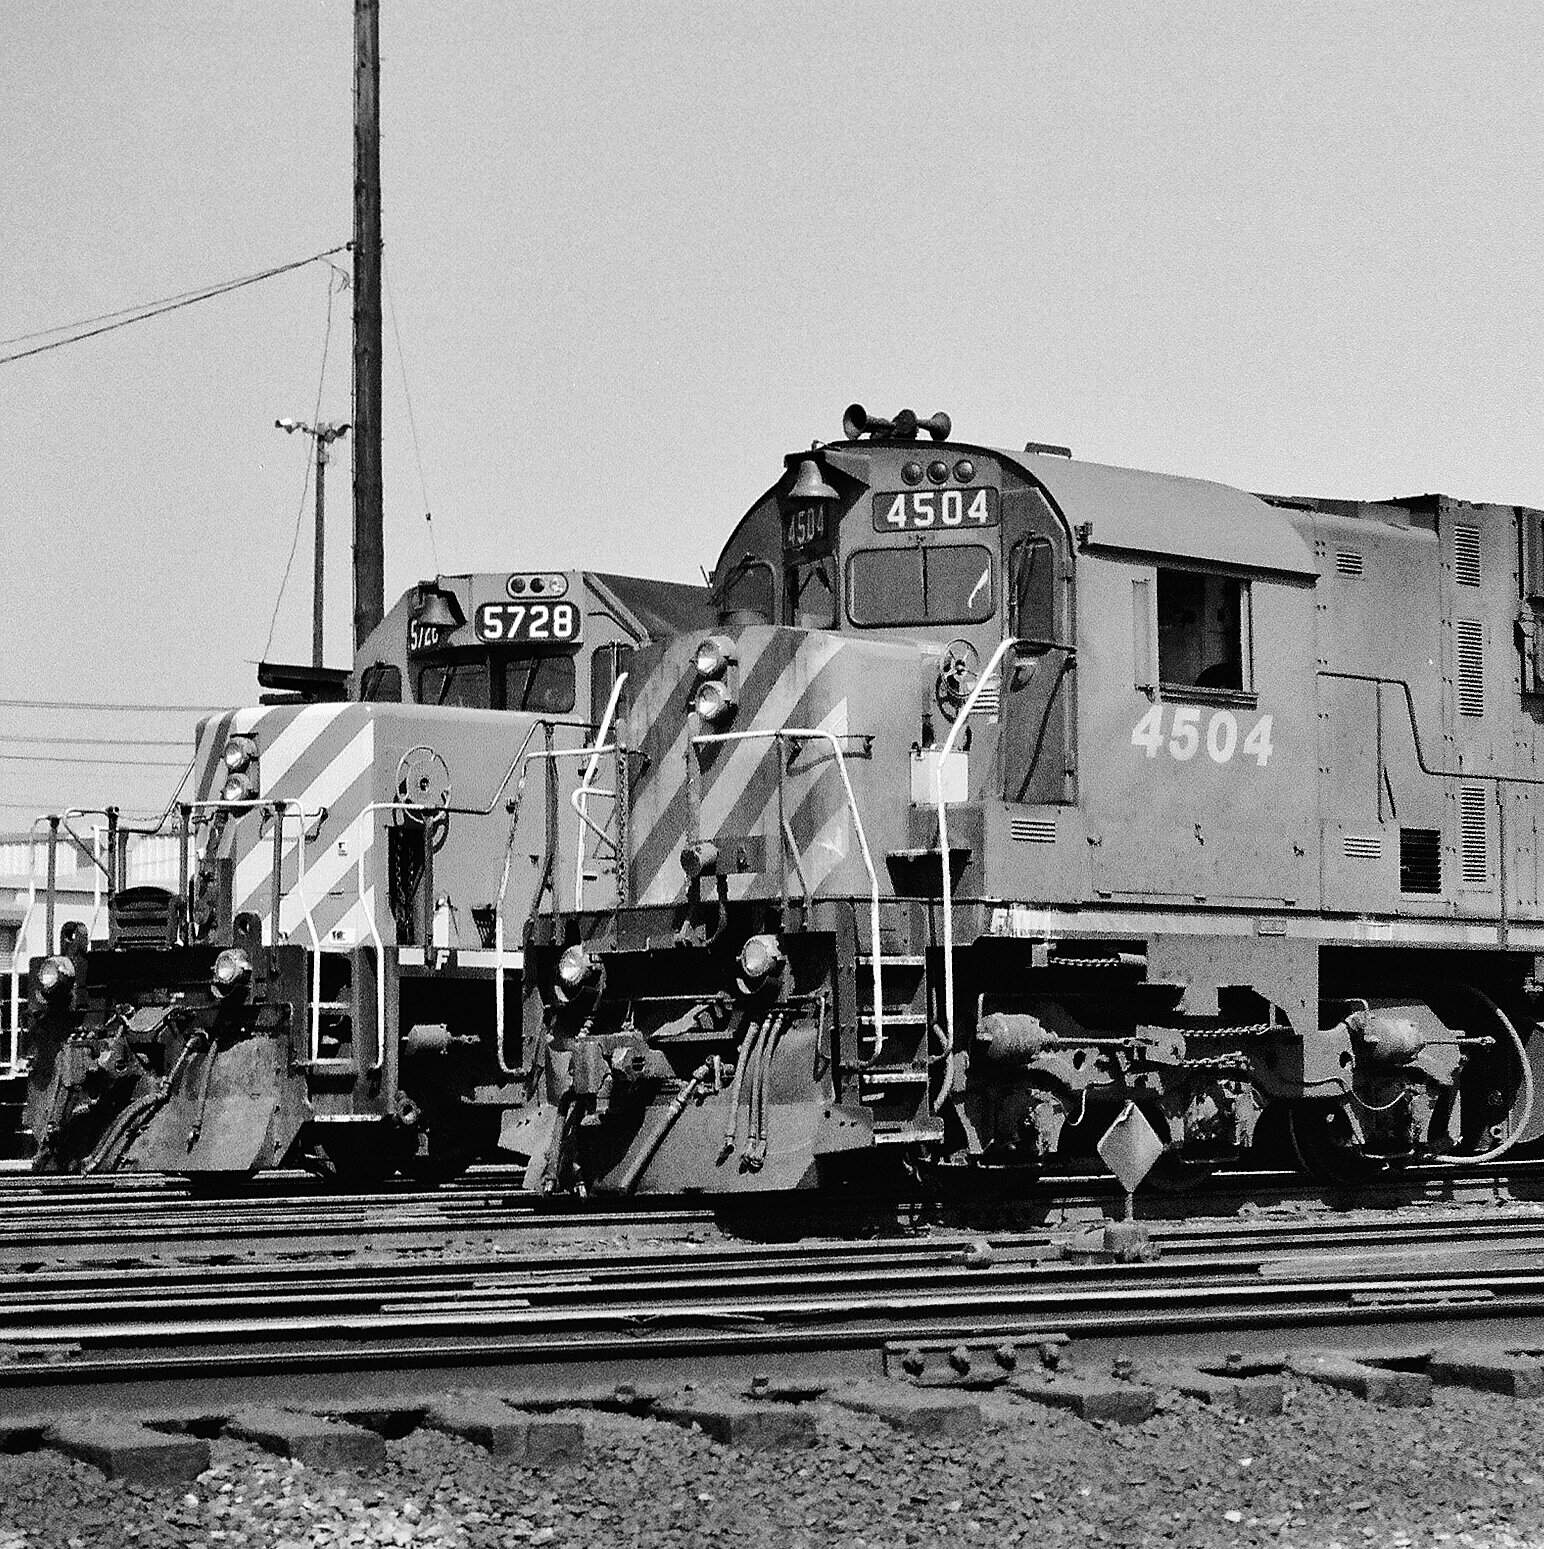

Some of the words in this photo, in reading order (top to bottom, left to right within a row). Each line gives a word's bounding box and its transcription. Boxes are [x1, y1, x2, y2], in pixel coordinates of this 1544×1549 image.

[788, 504, 824, 546] 4504
[887, 489, 988, 528] 4504
[483, 605, 572, 639] 5728
[1131, 704, 1274, 766] 4504
[435, 950, 450, 970] F
